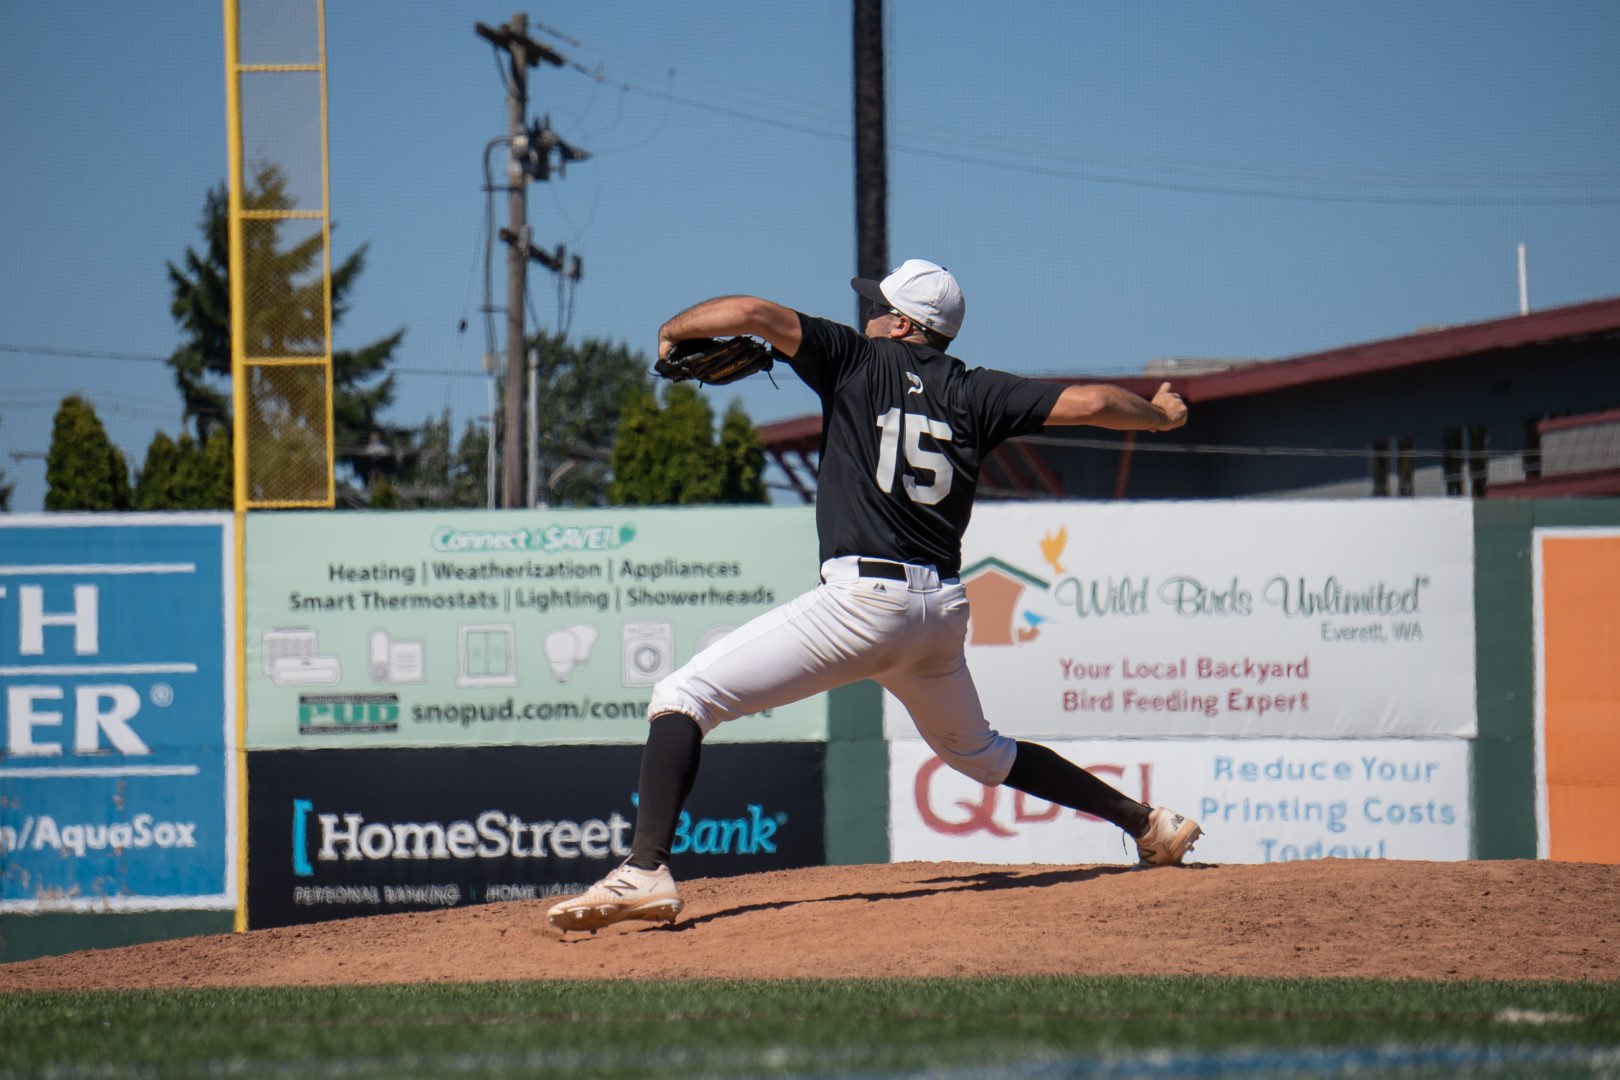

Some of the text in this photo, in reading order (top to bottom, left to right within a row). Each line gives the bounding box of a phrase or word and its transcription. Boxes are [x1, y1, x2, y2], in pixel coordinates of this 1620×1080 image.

[876, 407, 953, 505] 15
[432, 526, 532, 551] Connect
[545, 525, 612, 552] SAVE!
[328, 558, 742, 585] Heating Weatherization Appliances
[289, 586, 775, 611] Smart Thermostats Lighting Showerheads
[1055, 575, 1149, 618] Wild
[1158, 574, 1253, 617] Birds
[0, 584, 99, 656] H
[1392, 621, 1424, 641] WA
[1060, 656, 1310, 685] Your Local Backyard
[299, 703, 398, 725] PUD
[1062, 687, 1309, 717] Bird Feeding Expert
[1213, 756, 1439, 782] Reduce Your
[1200, 796, 1348, 833] Printing
[1363, 796, 1456, 825] Costs
[317, 810, 632, 860] HomeStreet
[384, 883, 461, 905] BANKING
